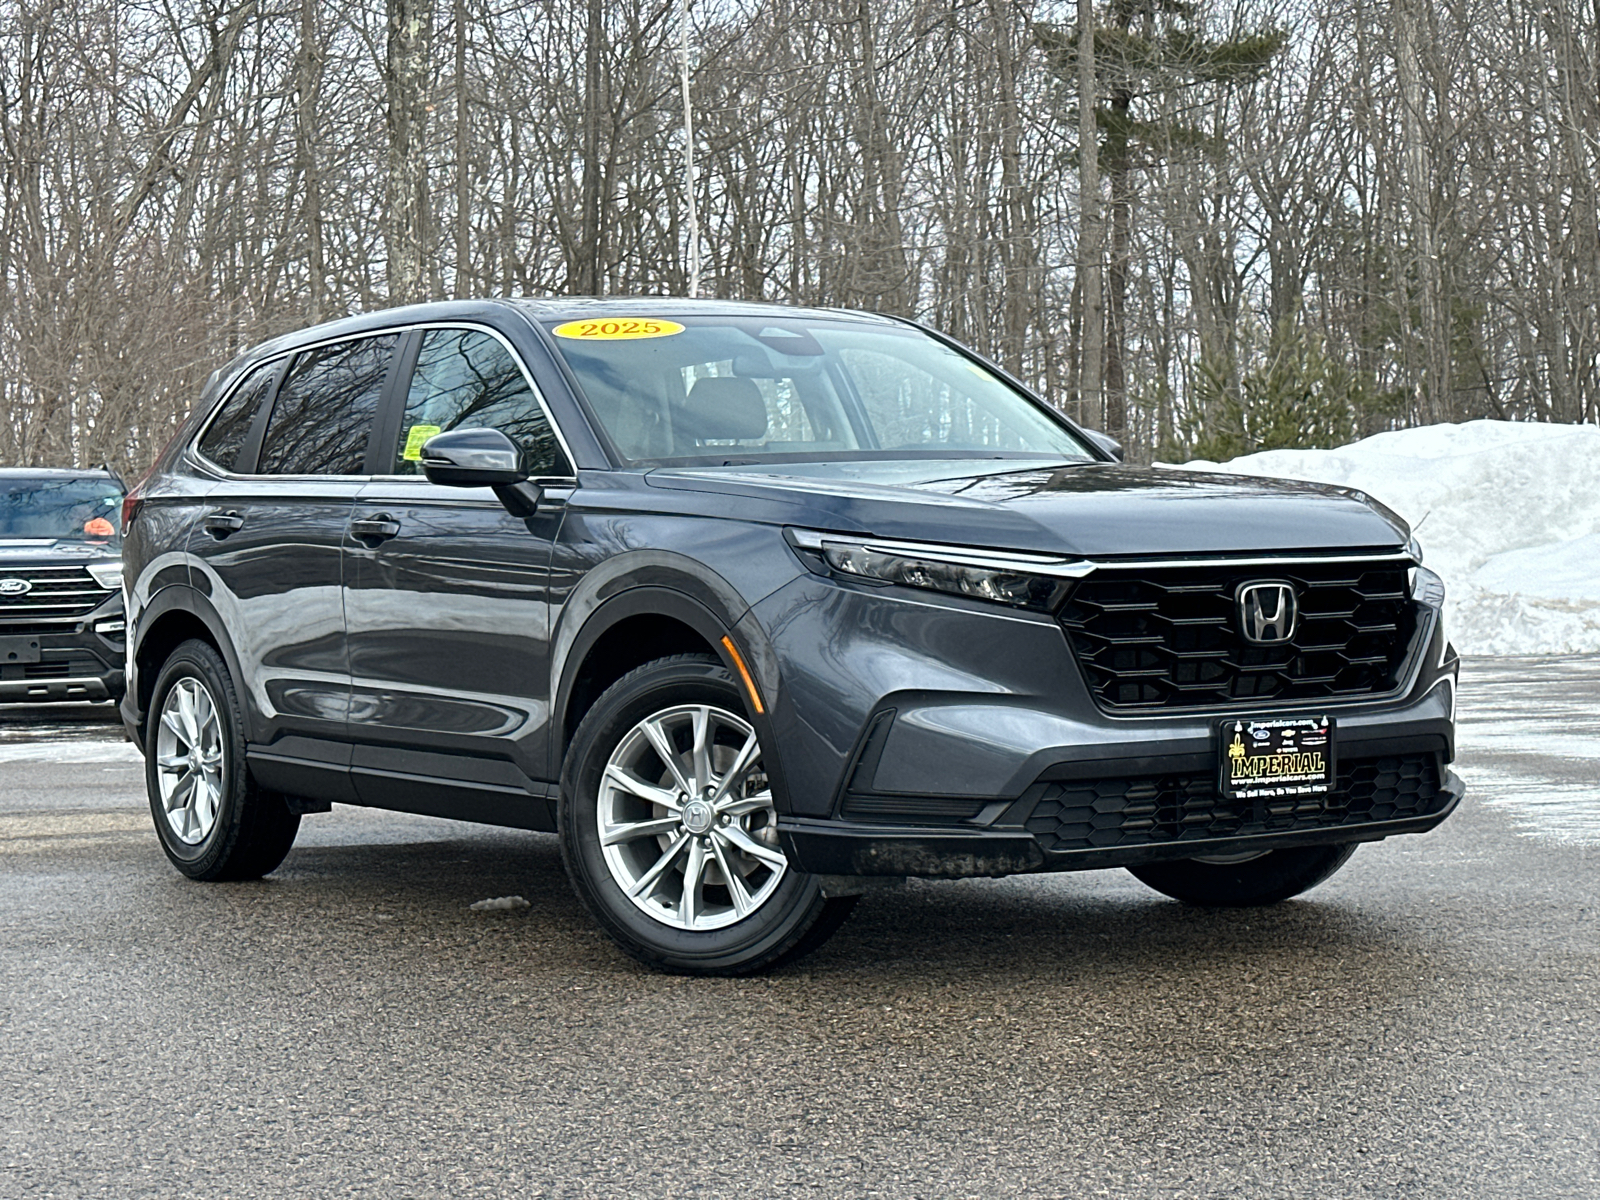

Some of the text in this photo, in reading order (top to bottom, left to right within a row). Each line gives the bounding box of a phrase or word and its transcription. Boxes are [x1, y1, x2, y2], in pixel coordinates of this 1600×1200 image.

[580, 322, 661, 336] 2025
[1231, 752, 1325, 778] IMPERIAL
[1231, 773, 1325, 785] www.imperialcars.com
